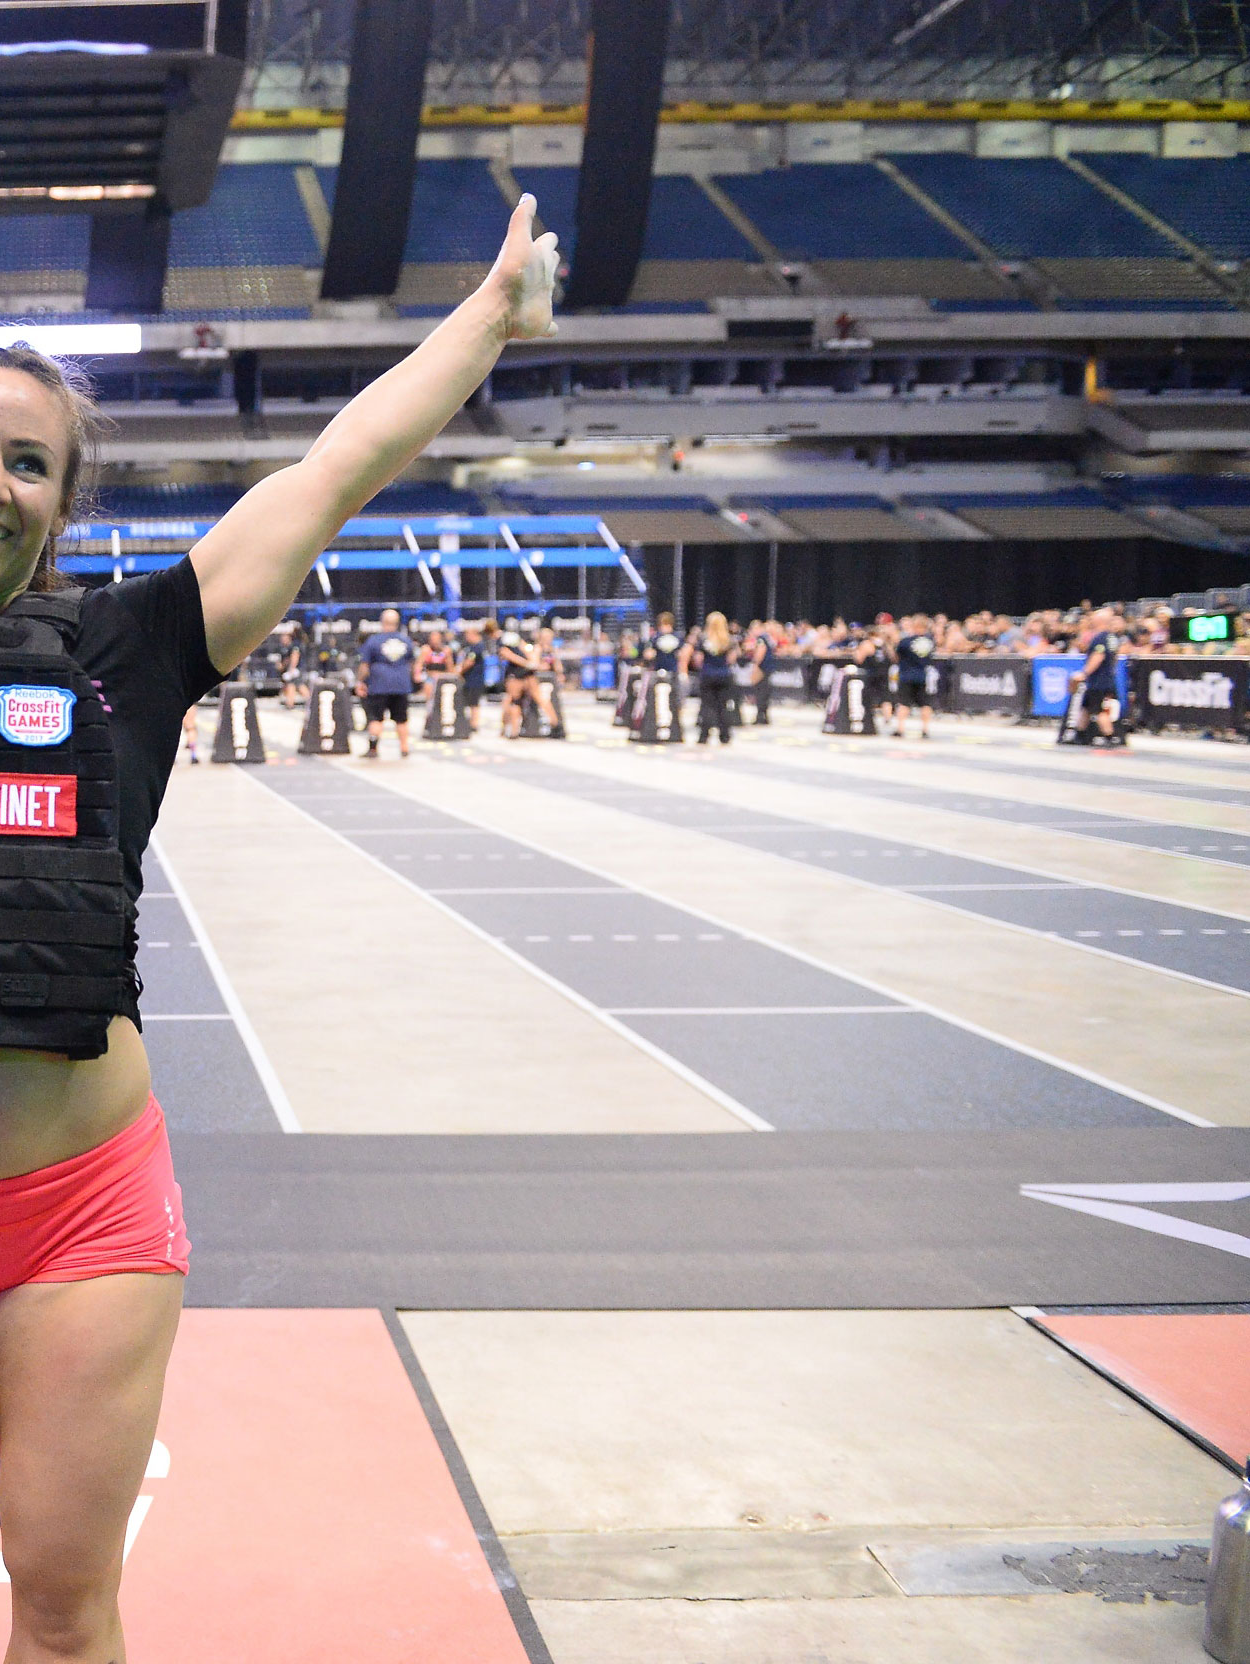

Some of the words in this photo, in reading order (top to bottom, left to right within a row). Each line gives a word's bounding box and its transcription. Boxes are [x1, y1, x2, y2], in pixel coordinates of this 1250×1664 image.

[15, 689, 55, 699] Reebok
[8, 699, 60, 713] CrossFit
[8, 714, 60, 728] GAMES
